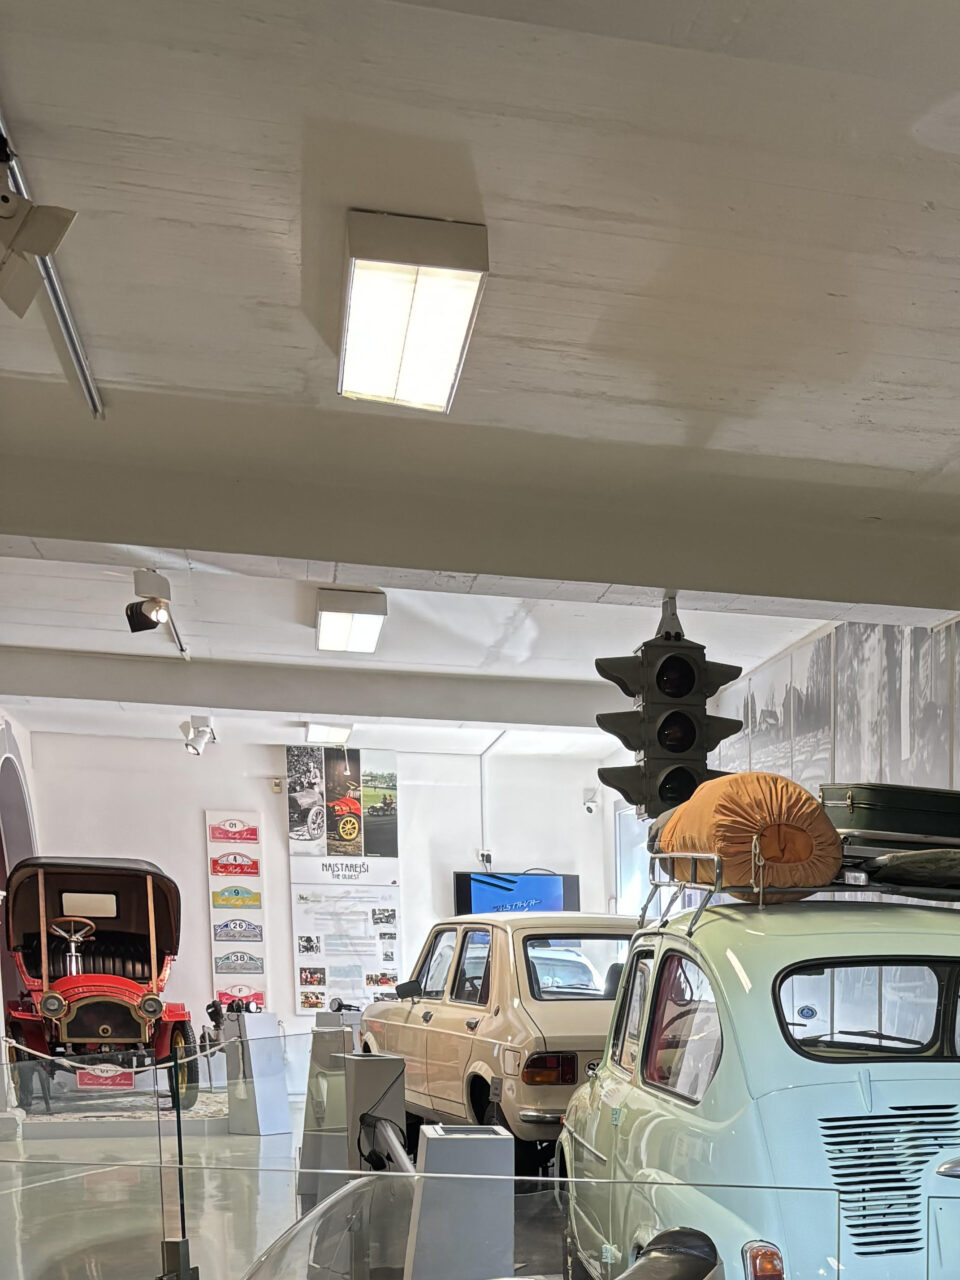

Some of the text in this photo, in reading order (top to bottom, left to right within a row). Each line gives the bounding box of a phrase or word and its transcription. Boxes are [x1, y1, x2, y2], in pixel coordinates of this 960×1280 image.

[322, 862, 369, 874] NAJSTAREJŠI
[232, 921, 244, 930] 26
[233, 954, 246, 962] 38
